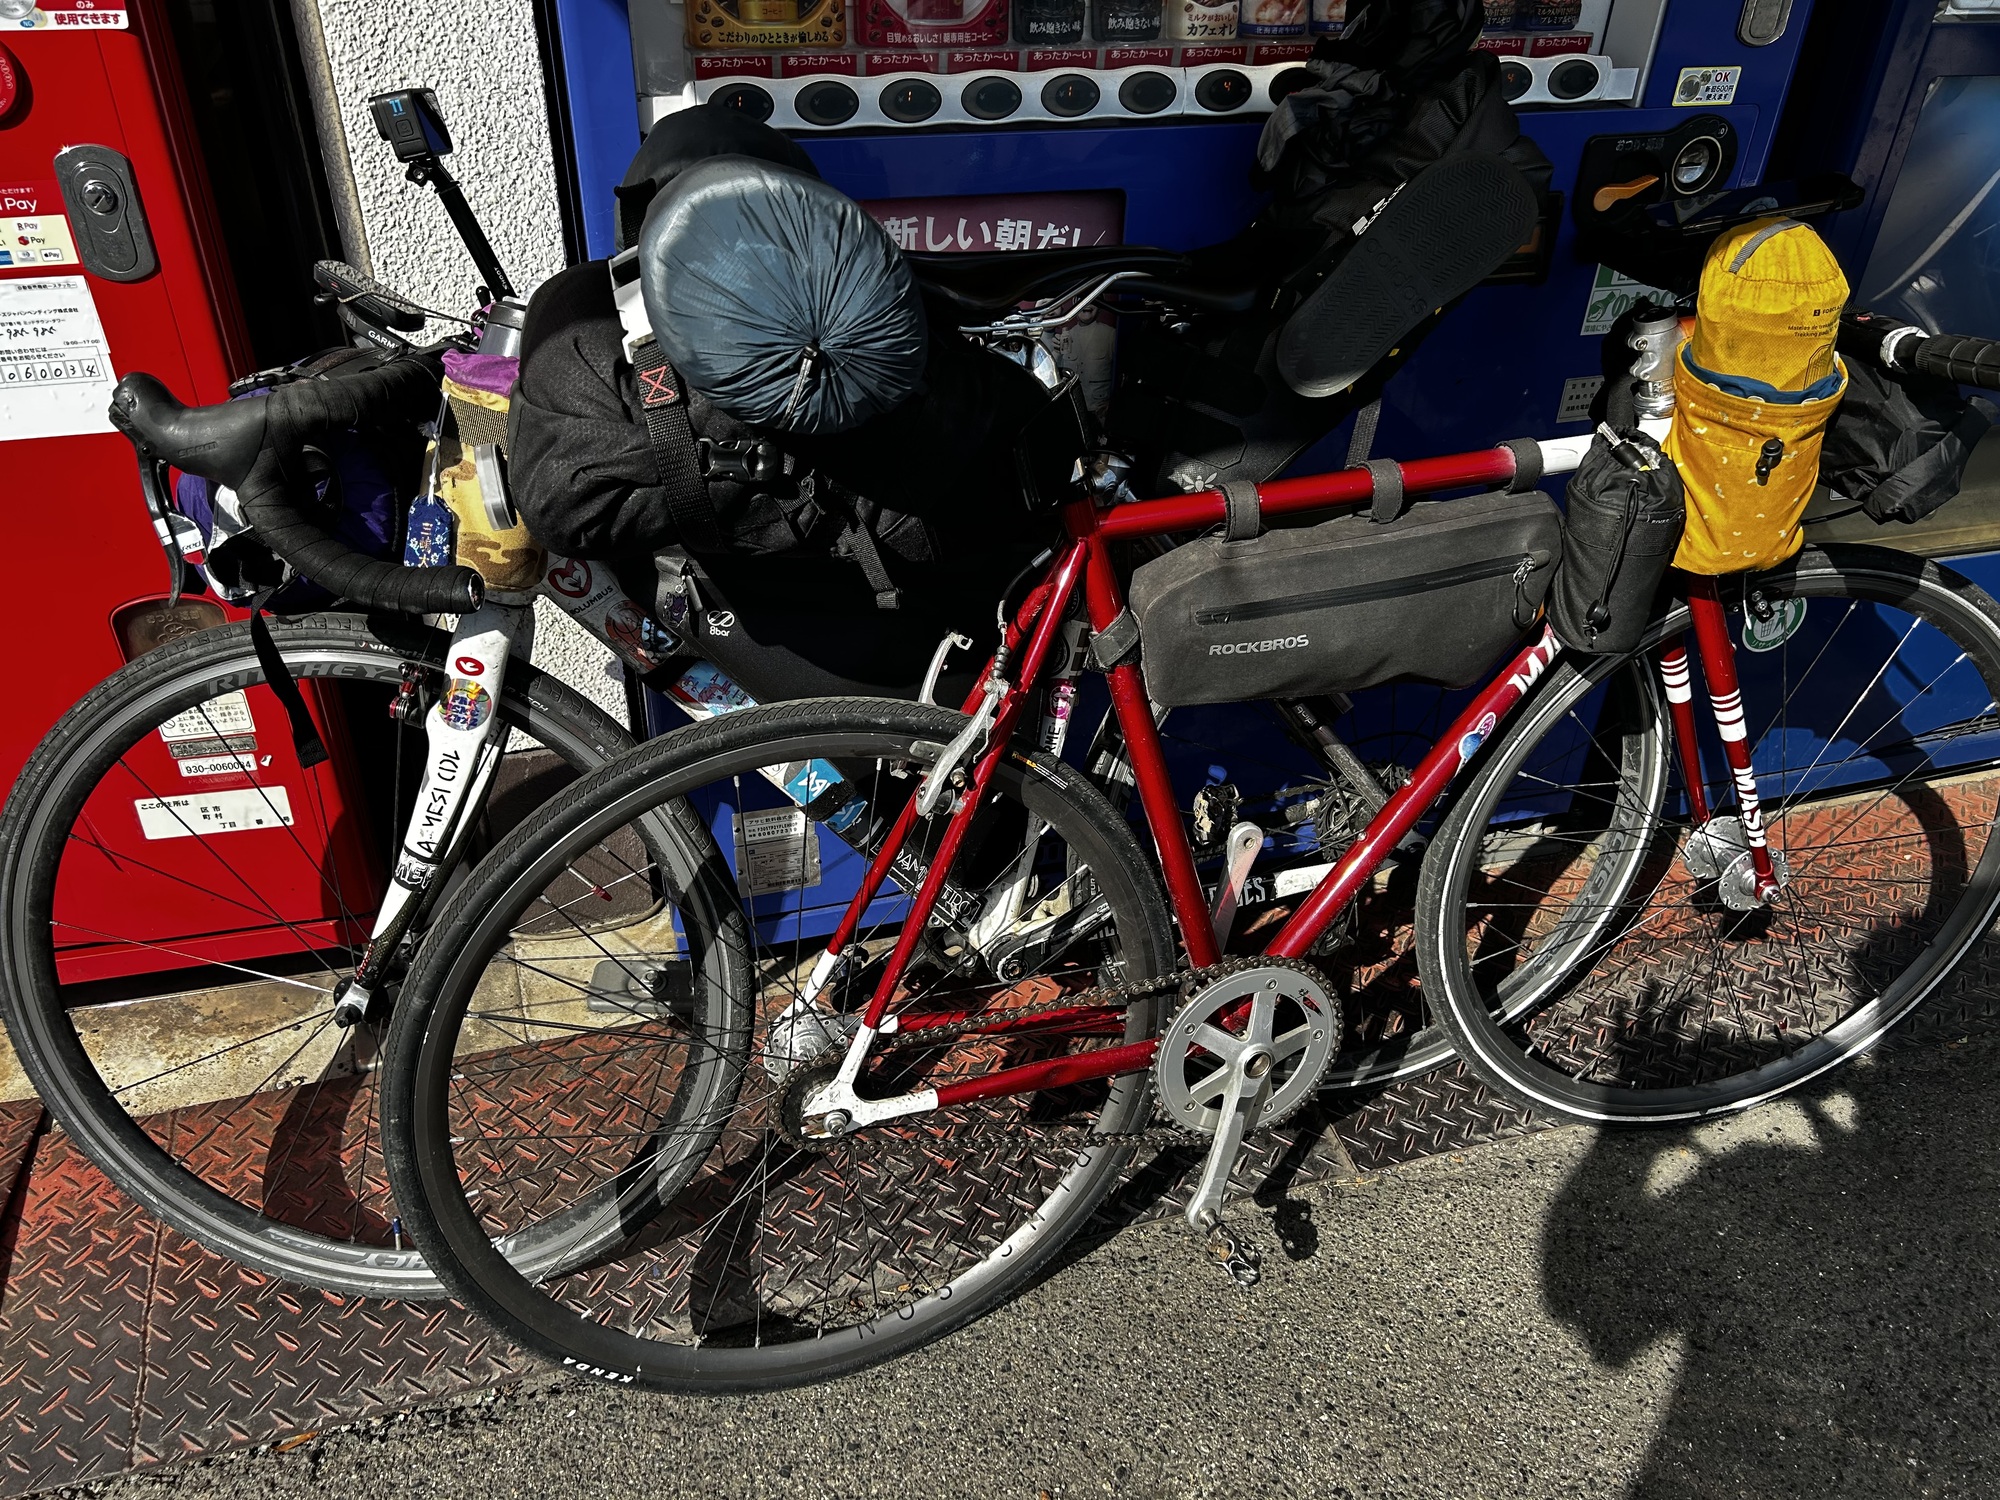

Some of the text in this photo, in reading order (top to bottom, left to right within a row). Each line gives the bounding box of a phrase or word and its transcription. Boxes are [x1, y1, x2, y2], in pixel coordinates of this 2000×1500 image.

[75, 0, 95, 9] のみ
[54, 13, 121, 25] 使用できます
[1186, 24, 1236, 36] カフェオレ
[717, 32, 829, 44] こだわりのひとときが愉しめる
[1715, 71, 1731, 82] OK
[389, 98, 404, 113] 11
[4, 197, 37, 213] Pay
[30, 236, 46, 244] Pay
[367, 330, 398, 349] GARM
[569, 585, 614, 616] COLUMBUS
[708, 626, 731, 638] 8bar
[1208, 633, 1310, 656] ROCKBROS
[208, 660, 387, 695] RITHEY
[219, 821, 237, 829] 丁目
[562, 1356, 634, 1384] KENDA
